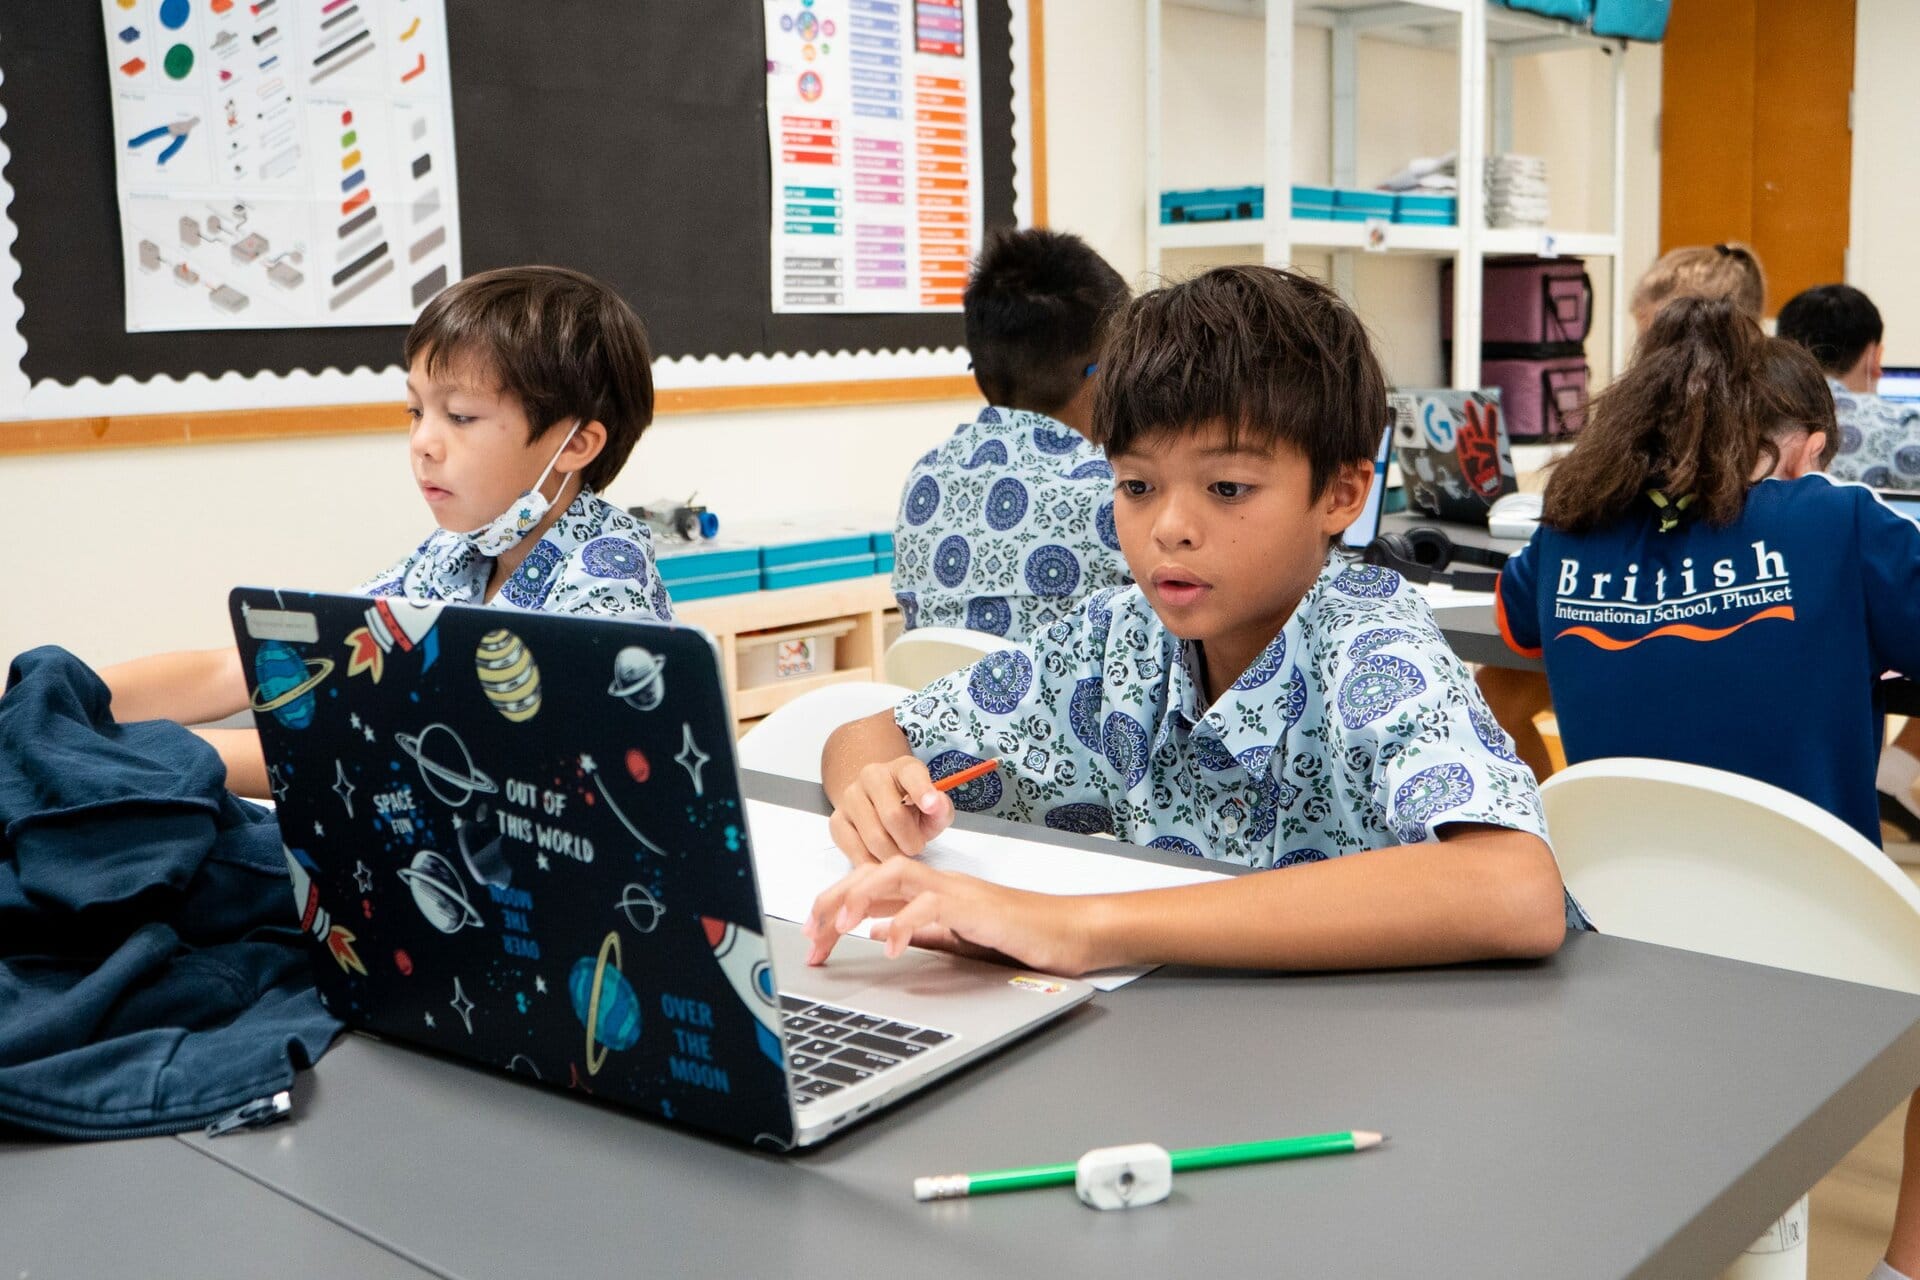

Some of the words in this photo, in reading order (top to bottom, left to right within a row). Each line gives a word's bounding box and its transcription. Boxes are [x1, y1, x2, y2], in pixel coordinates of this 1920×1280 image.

[1556, 540, 1789, 602] British
[1555, 602, 1651, 625] International
[1653, 597, 1718, 623] School,
[1722, 585, 1792, 610] Phuket
[373, 789, 416, 814] SPACE
[506, 778, 537, 808] OUT
[542, 791, 567, 818] OF
[391, 818, 414, 835] FUN
[496, 809, 533, 844] THIS
[535, 824, 594, 863] WORLD
[661, 992, 715, 1029] OVER
[673, 1028, 712, 1060] THE
[668, 1055, 730, 1095] MOON
